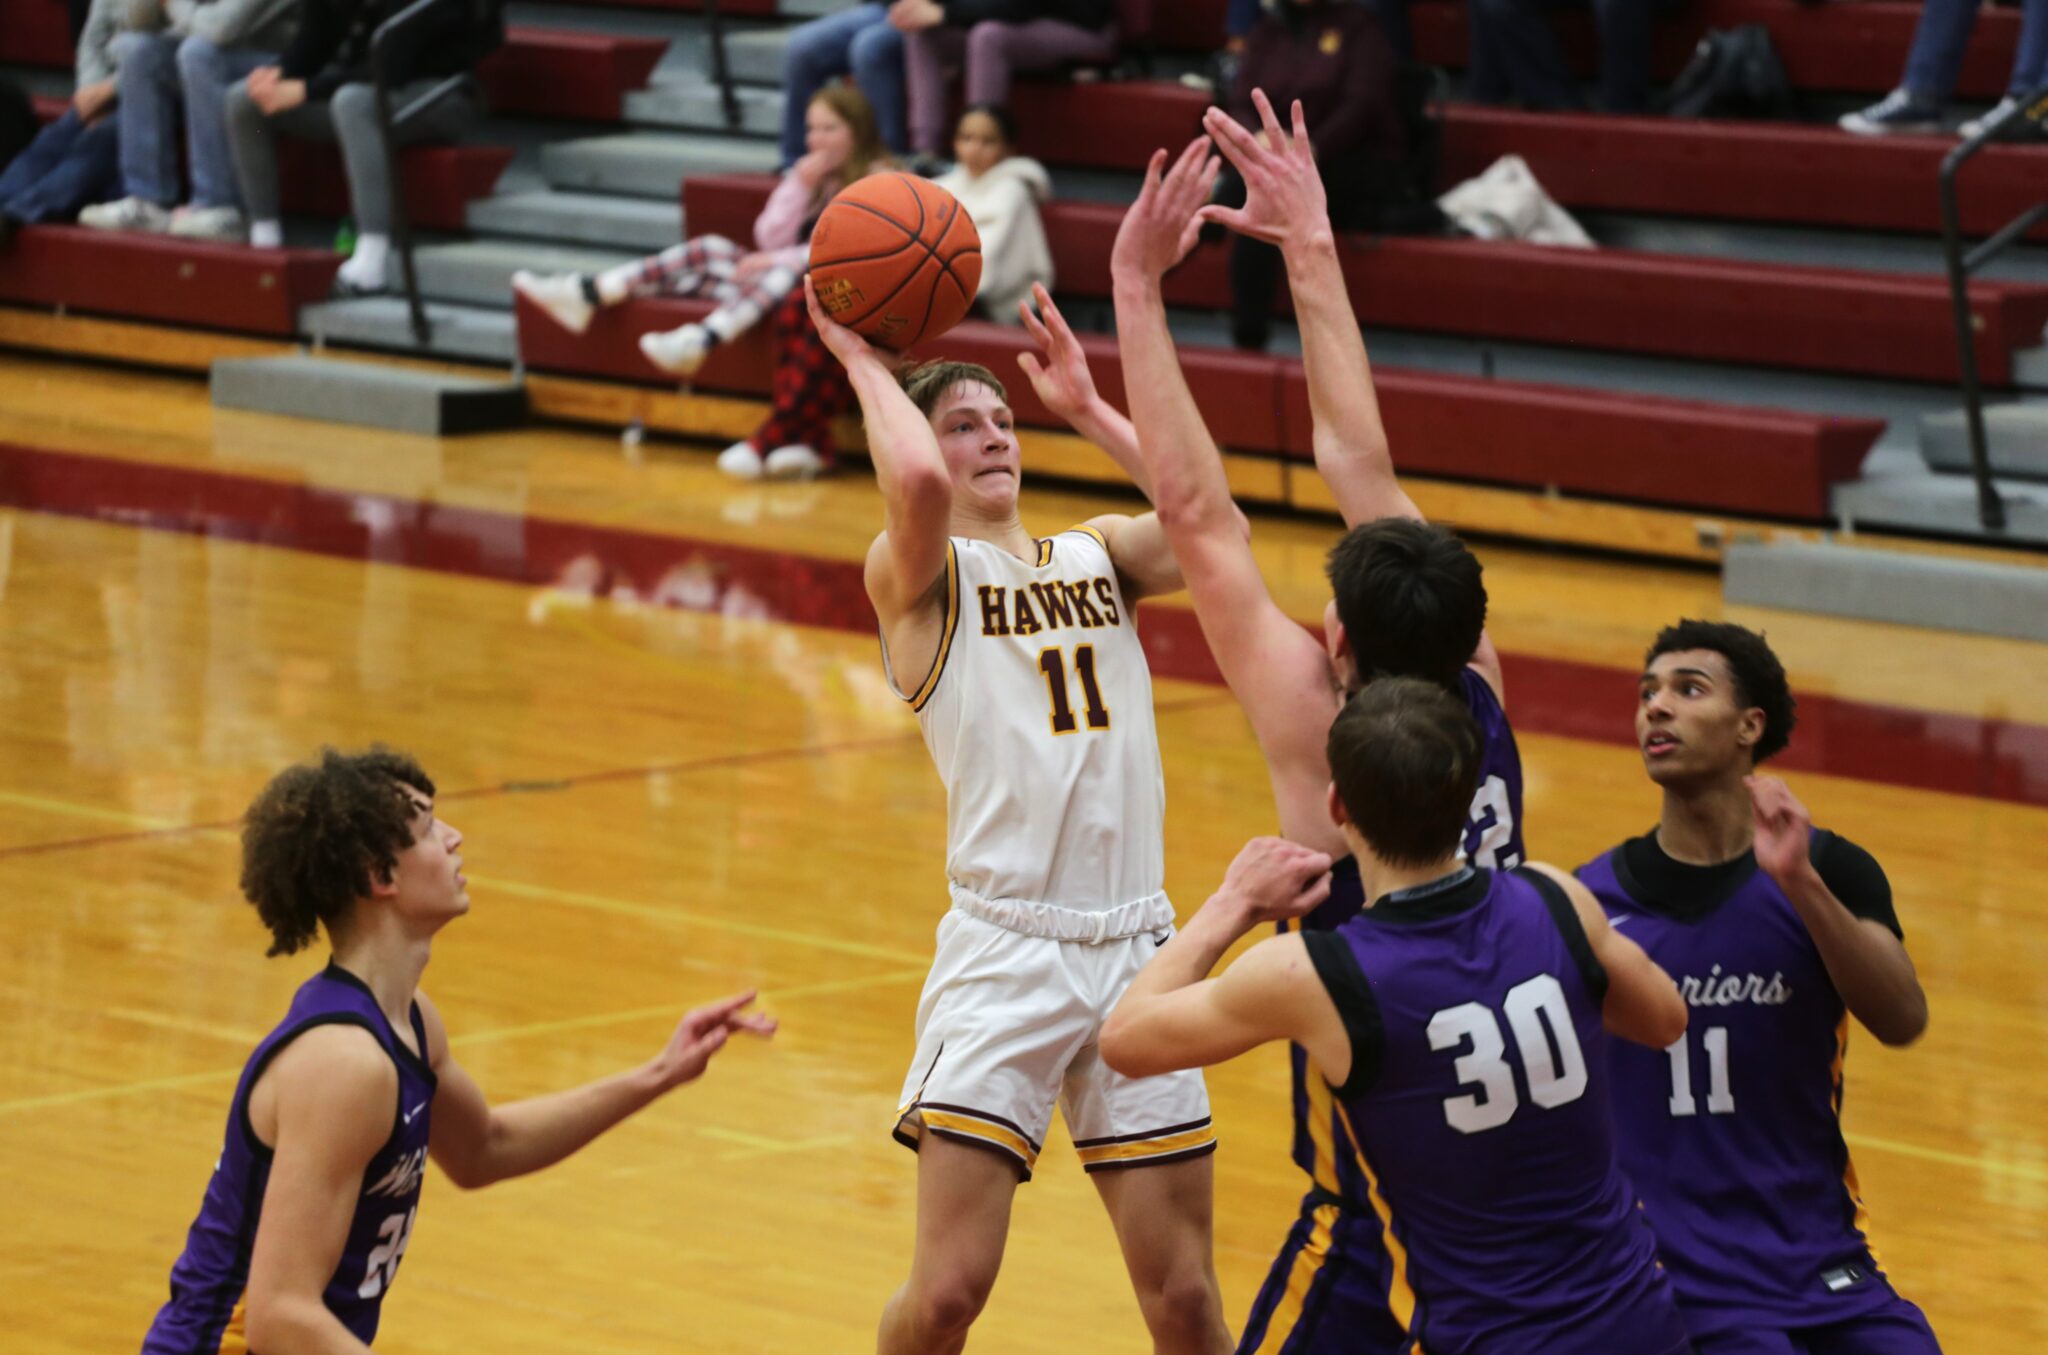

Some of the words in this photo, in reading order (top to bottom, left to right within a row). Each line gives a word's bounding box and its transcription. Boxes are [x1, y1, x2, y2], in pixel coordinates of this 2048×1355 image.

[977, 577, 1120, 636] HAWKS
[1037, 643, 1111, 736] 11
[1456, 774, 1519, 871] 2
[1675, 963, 1793, 1007] riors
[1425, 973, 1588, 1134] 30
[1665, 1026, 1735, 1116] 11
